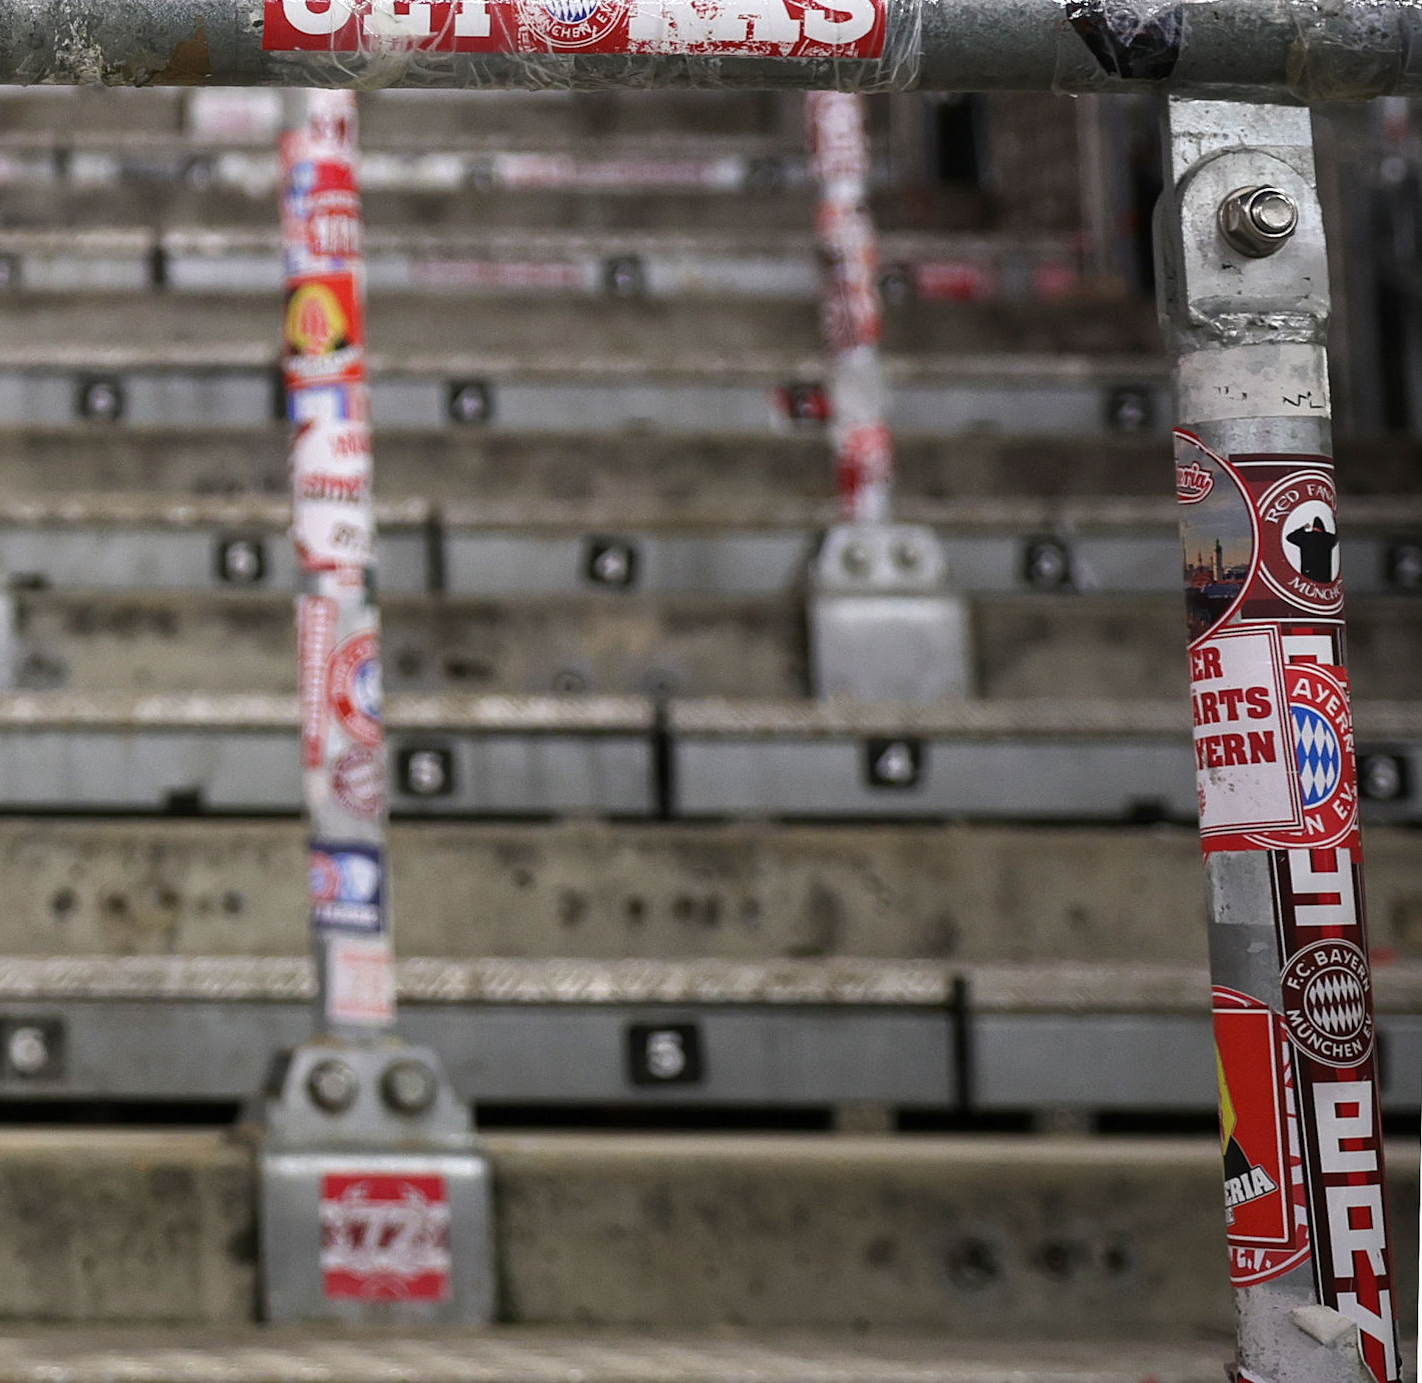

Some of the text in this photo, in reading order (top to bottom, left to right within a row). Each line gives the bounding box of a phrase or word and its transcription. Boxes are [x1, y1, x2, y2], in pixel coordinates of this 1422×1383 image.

[1291, 677, 1357, 753] AYERN
[878, 744, 912, 786] 4
[1313, 948, 1371, 993] BAYERN
[9, 1027, 48, 1072] 6
[645, 1031, 684, 1078] 5
[1286, 1009, 1363, 1058] MÜNCHEN
